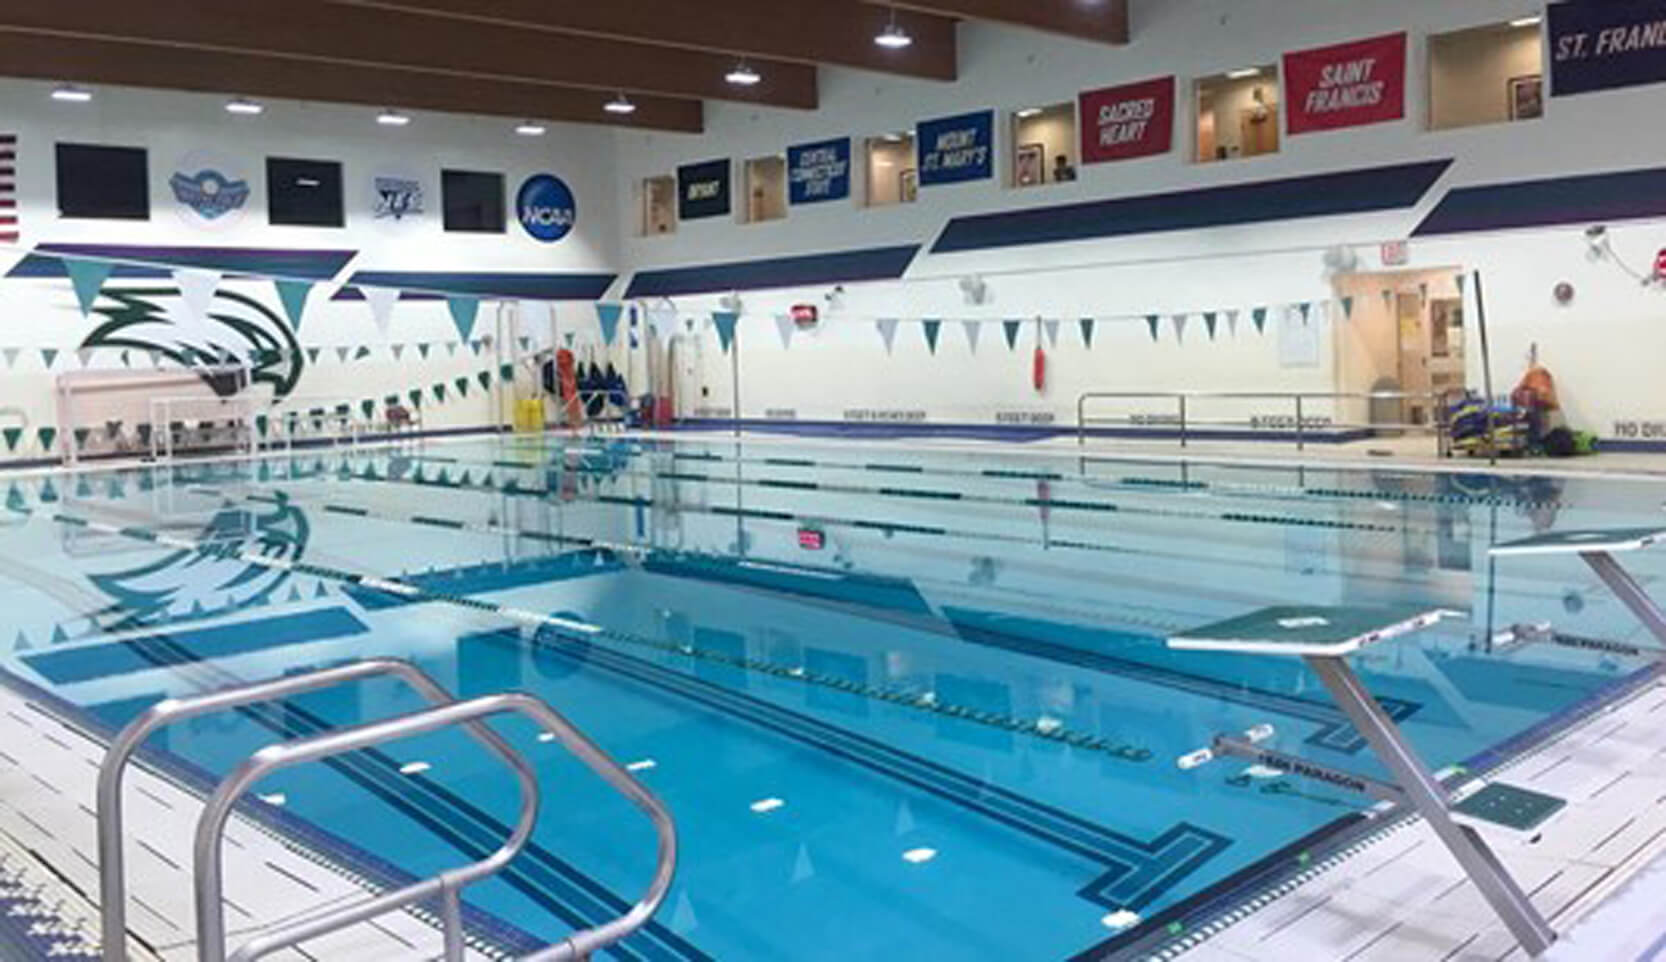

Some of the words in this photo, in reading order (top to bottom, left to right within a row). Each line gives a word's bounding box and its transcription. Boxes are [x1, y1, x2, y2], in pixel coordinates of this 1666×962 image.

[1555, 32, 1588, 61] ST.
[1319, 58, 1377, 89] SAINT
[1098, 98, 1155, 125] SACRED
[1304, 81, 1385, 113] FRANCIS
[1099, 120, 1148, 146] HEART
[521, 204, 574, 226] NCAA
[1294, 762, 1365, 792] PARAGON
